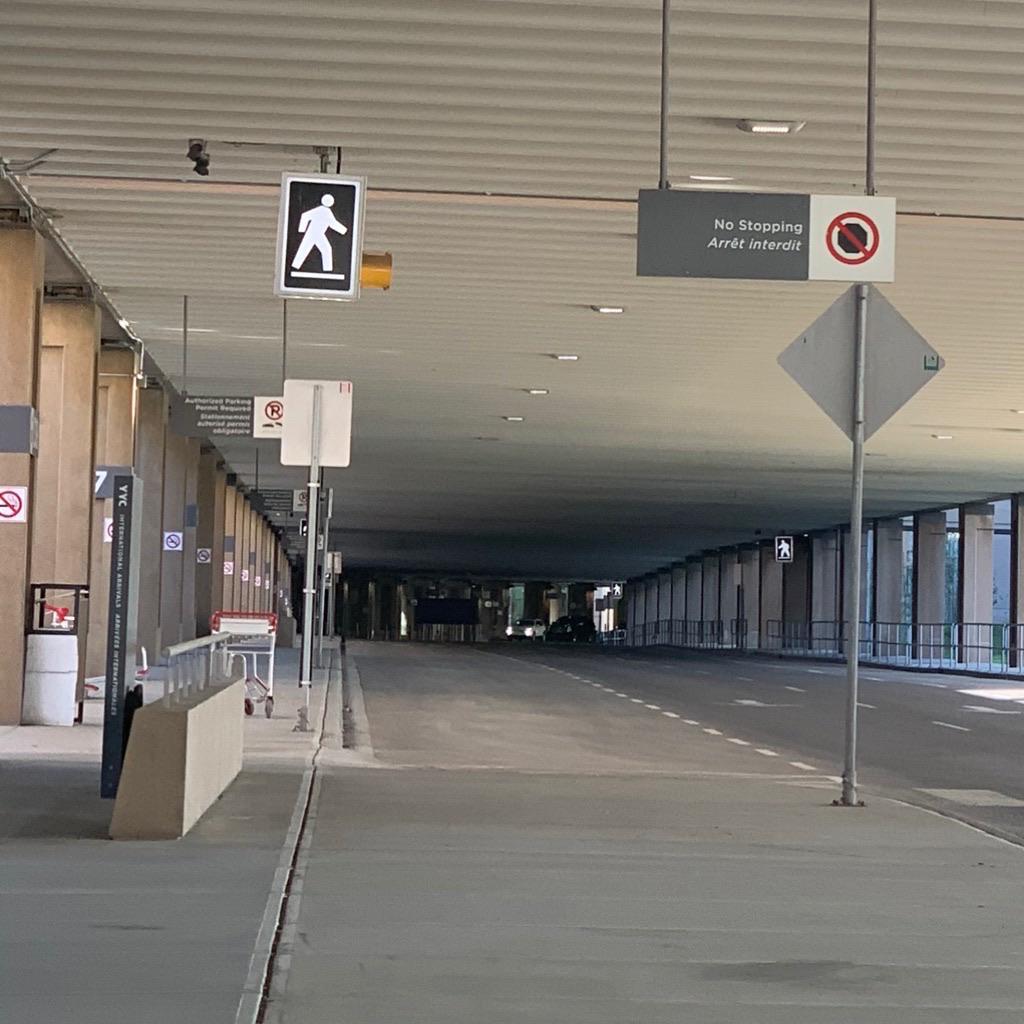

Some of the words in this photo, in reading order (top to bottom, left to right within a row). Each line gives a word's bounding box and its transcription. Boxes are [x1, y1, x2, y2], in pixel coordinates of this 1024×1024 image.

[714, 218, 735, 231] No
[738, 219, 804, 235] Stopping
[707, 236, 746, 250] Arrêt
[749, 238, 803, 252] interdit
[184, 397, 224, 405] Authorized
[225, 398, 252, 406] Parking
[195, 404, 219, 412] Permit
[220, 405, 252, 413] Required
[200, 413, 251, 421] Stationnement
[94, 470, 108, 494] 7
[118, 484, 129, 508] YYC
[116, 513, 126, 571] INTERNATIONAL
[115, 573, 123, 609] ARRIVALS
